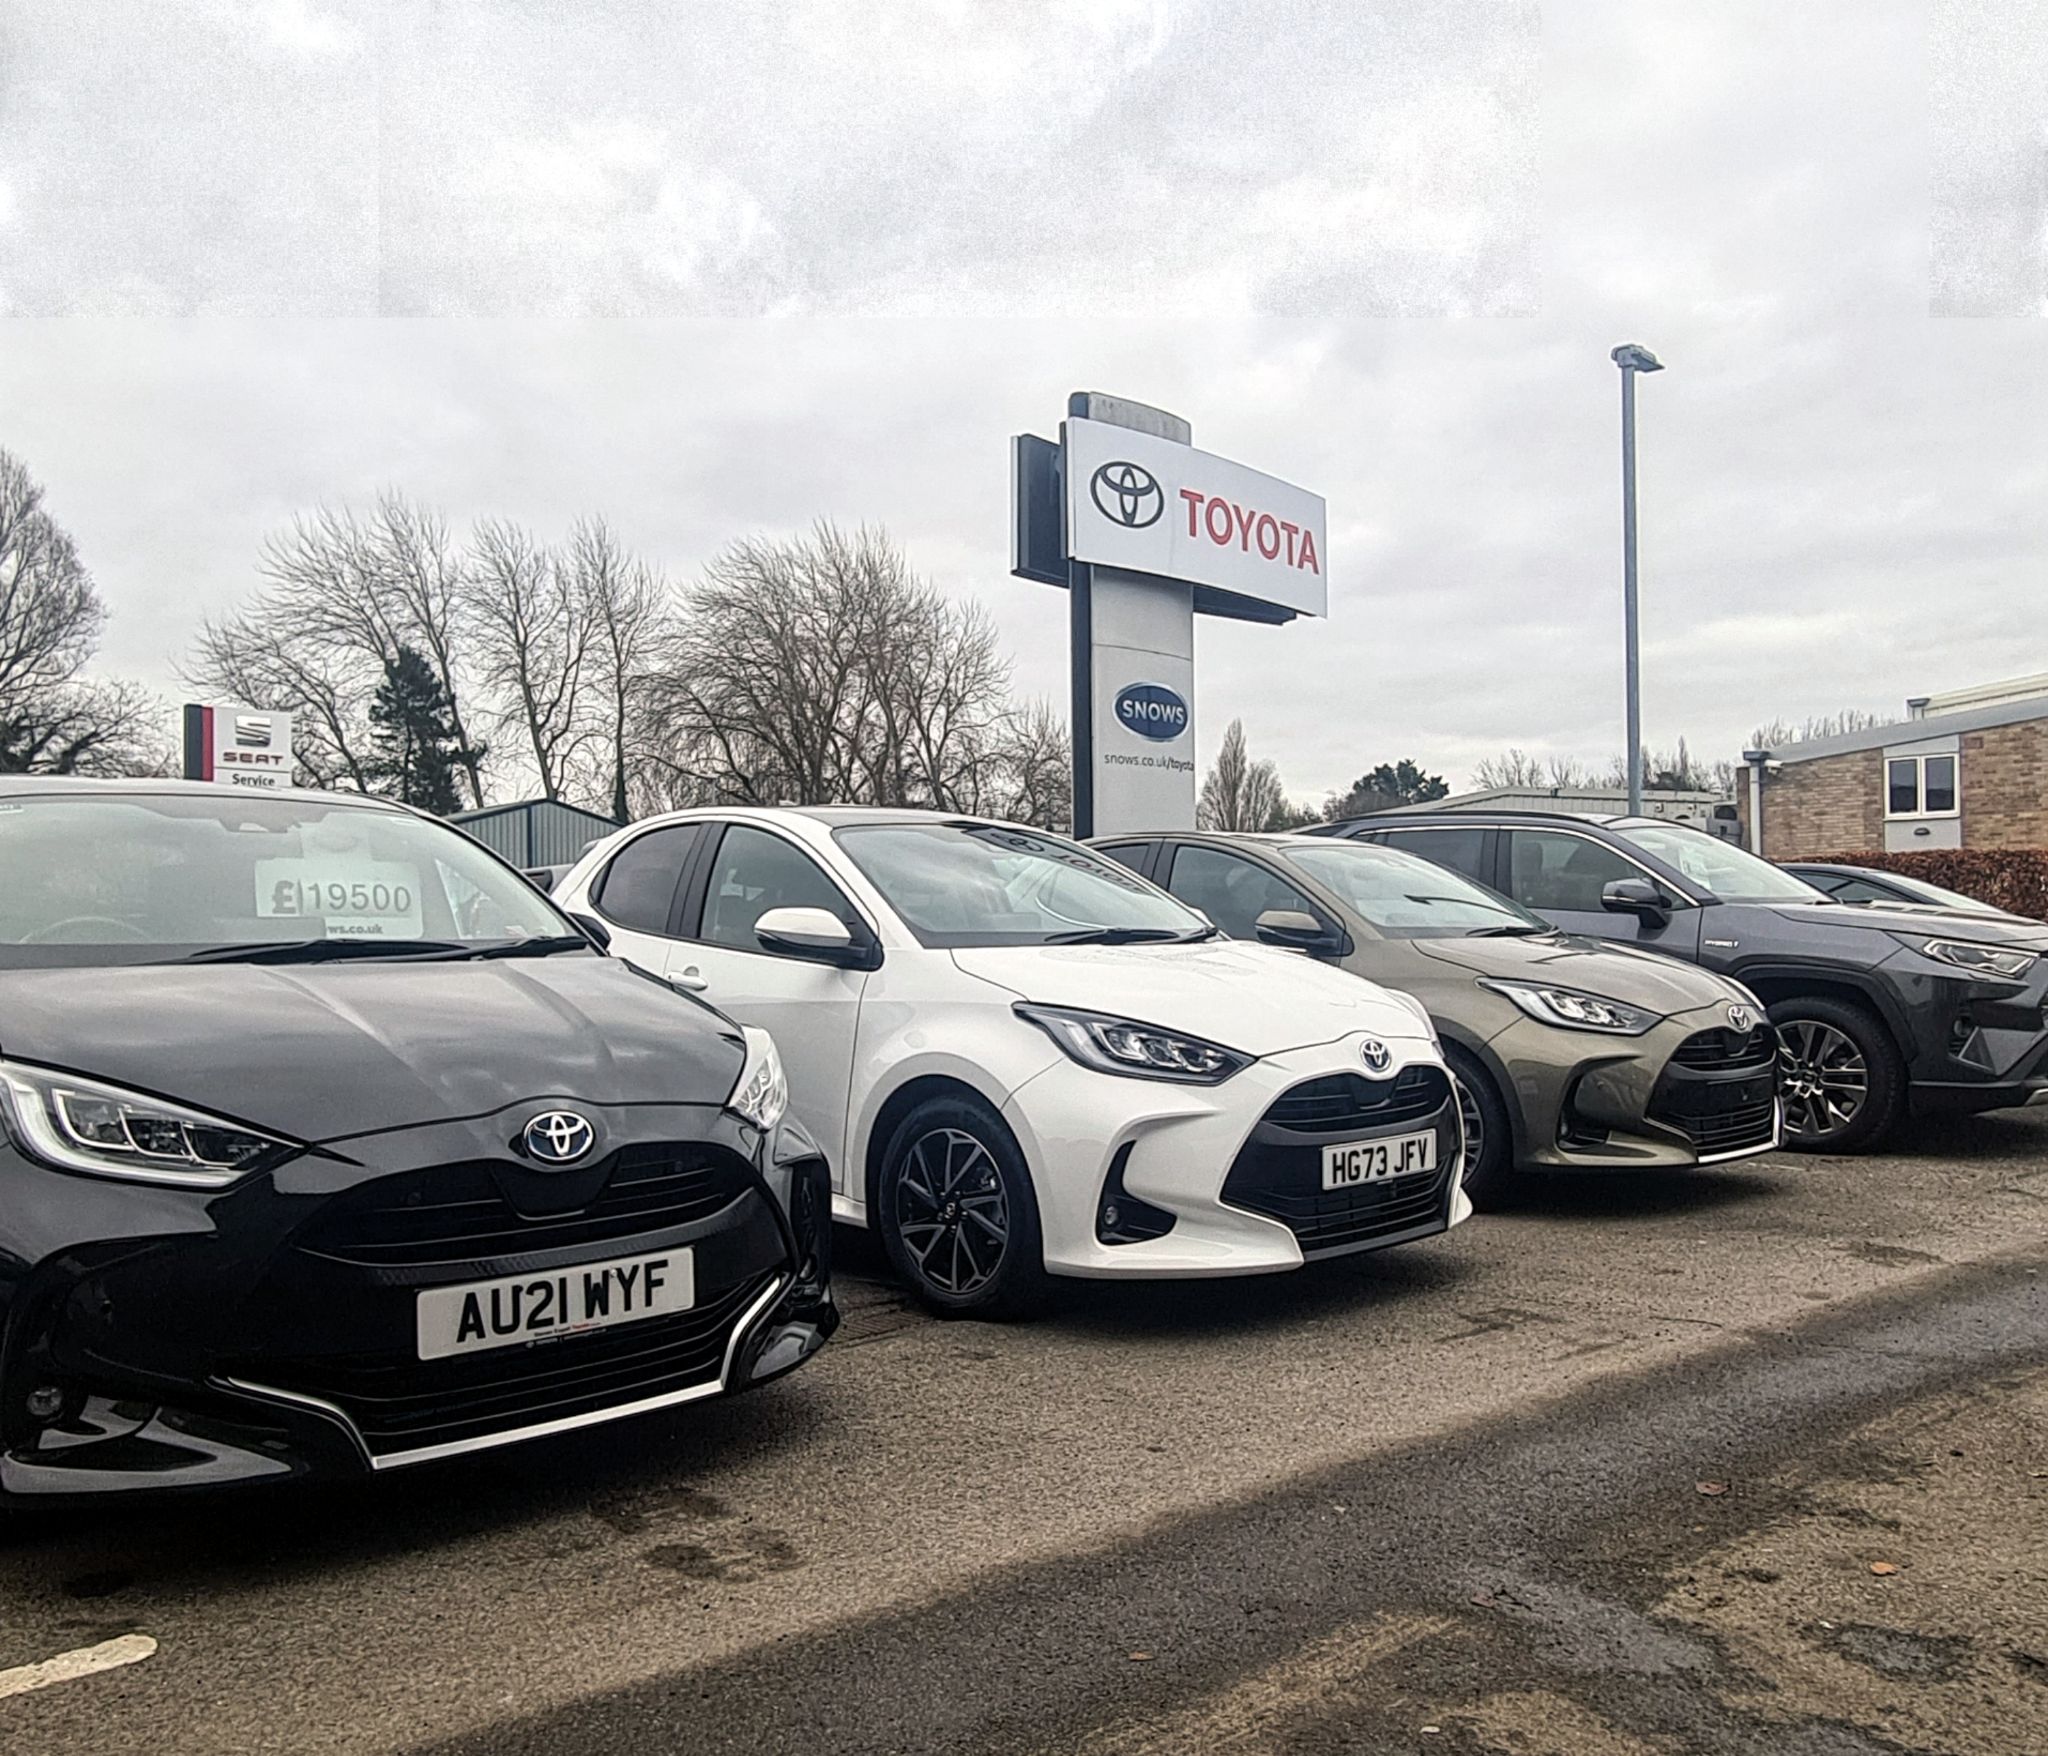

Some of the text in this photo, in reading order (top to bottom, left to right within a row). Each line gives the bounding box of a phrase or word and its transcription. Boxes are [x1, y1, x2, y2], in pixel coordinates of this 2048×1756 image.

[1180, 488, 1319, 575] TOYOTA
[1122, 699, 1185, 725] SNOWS
[223, 751, 284, 765] SEAT
[232, 773, 275, 786] Service
[1332, 1137, 1428, 1185] HG73 JFV
[456, 1259, 669, 1344] AU21 WYF
